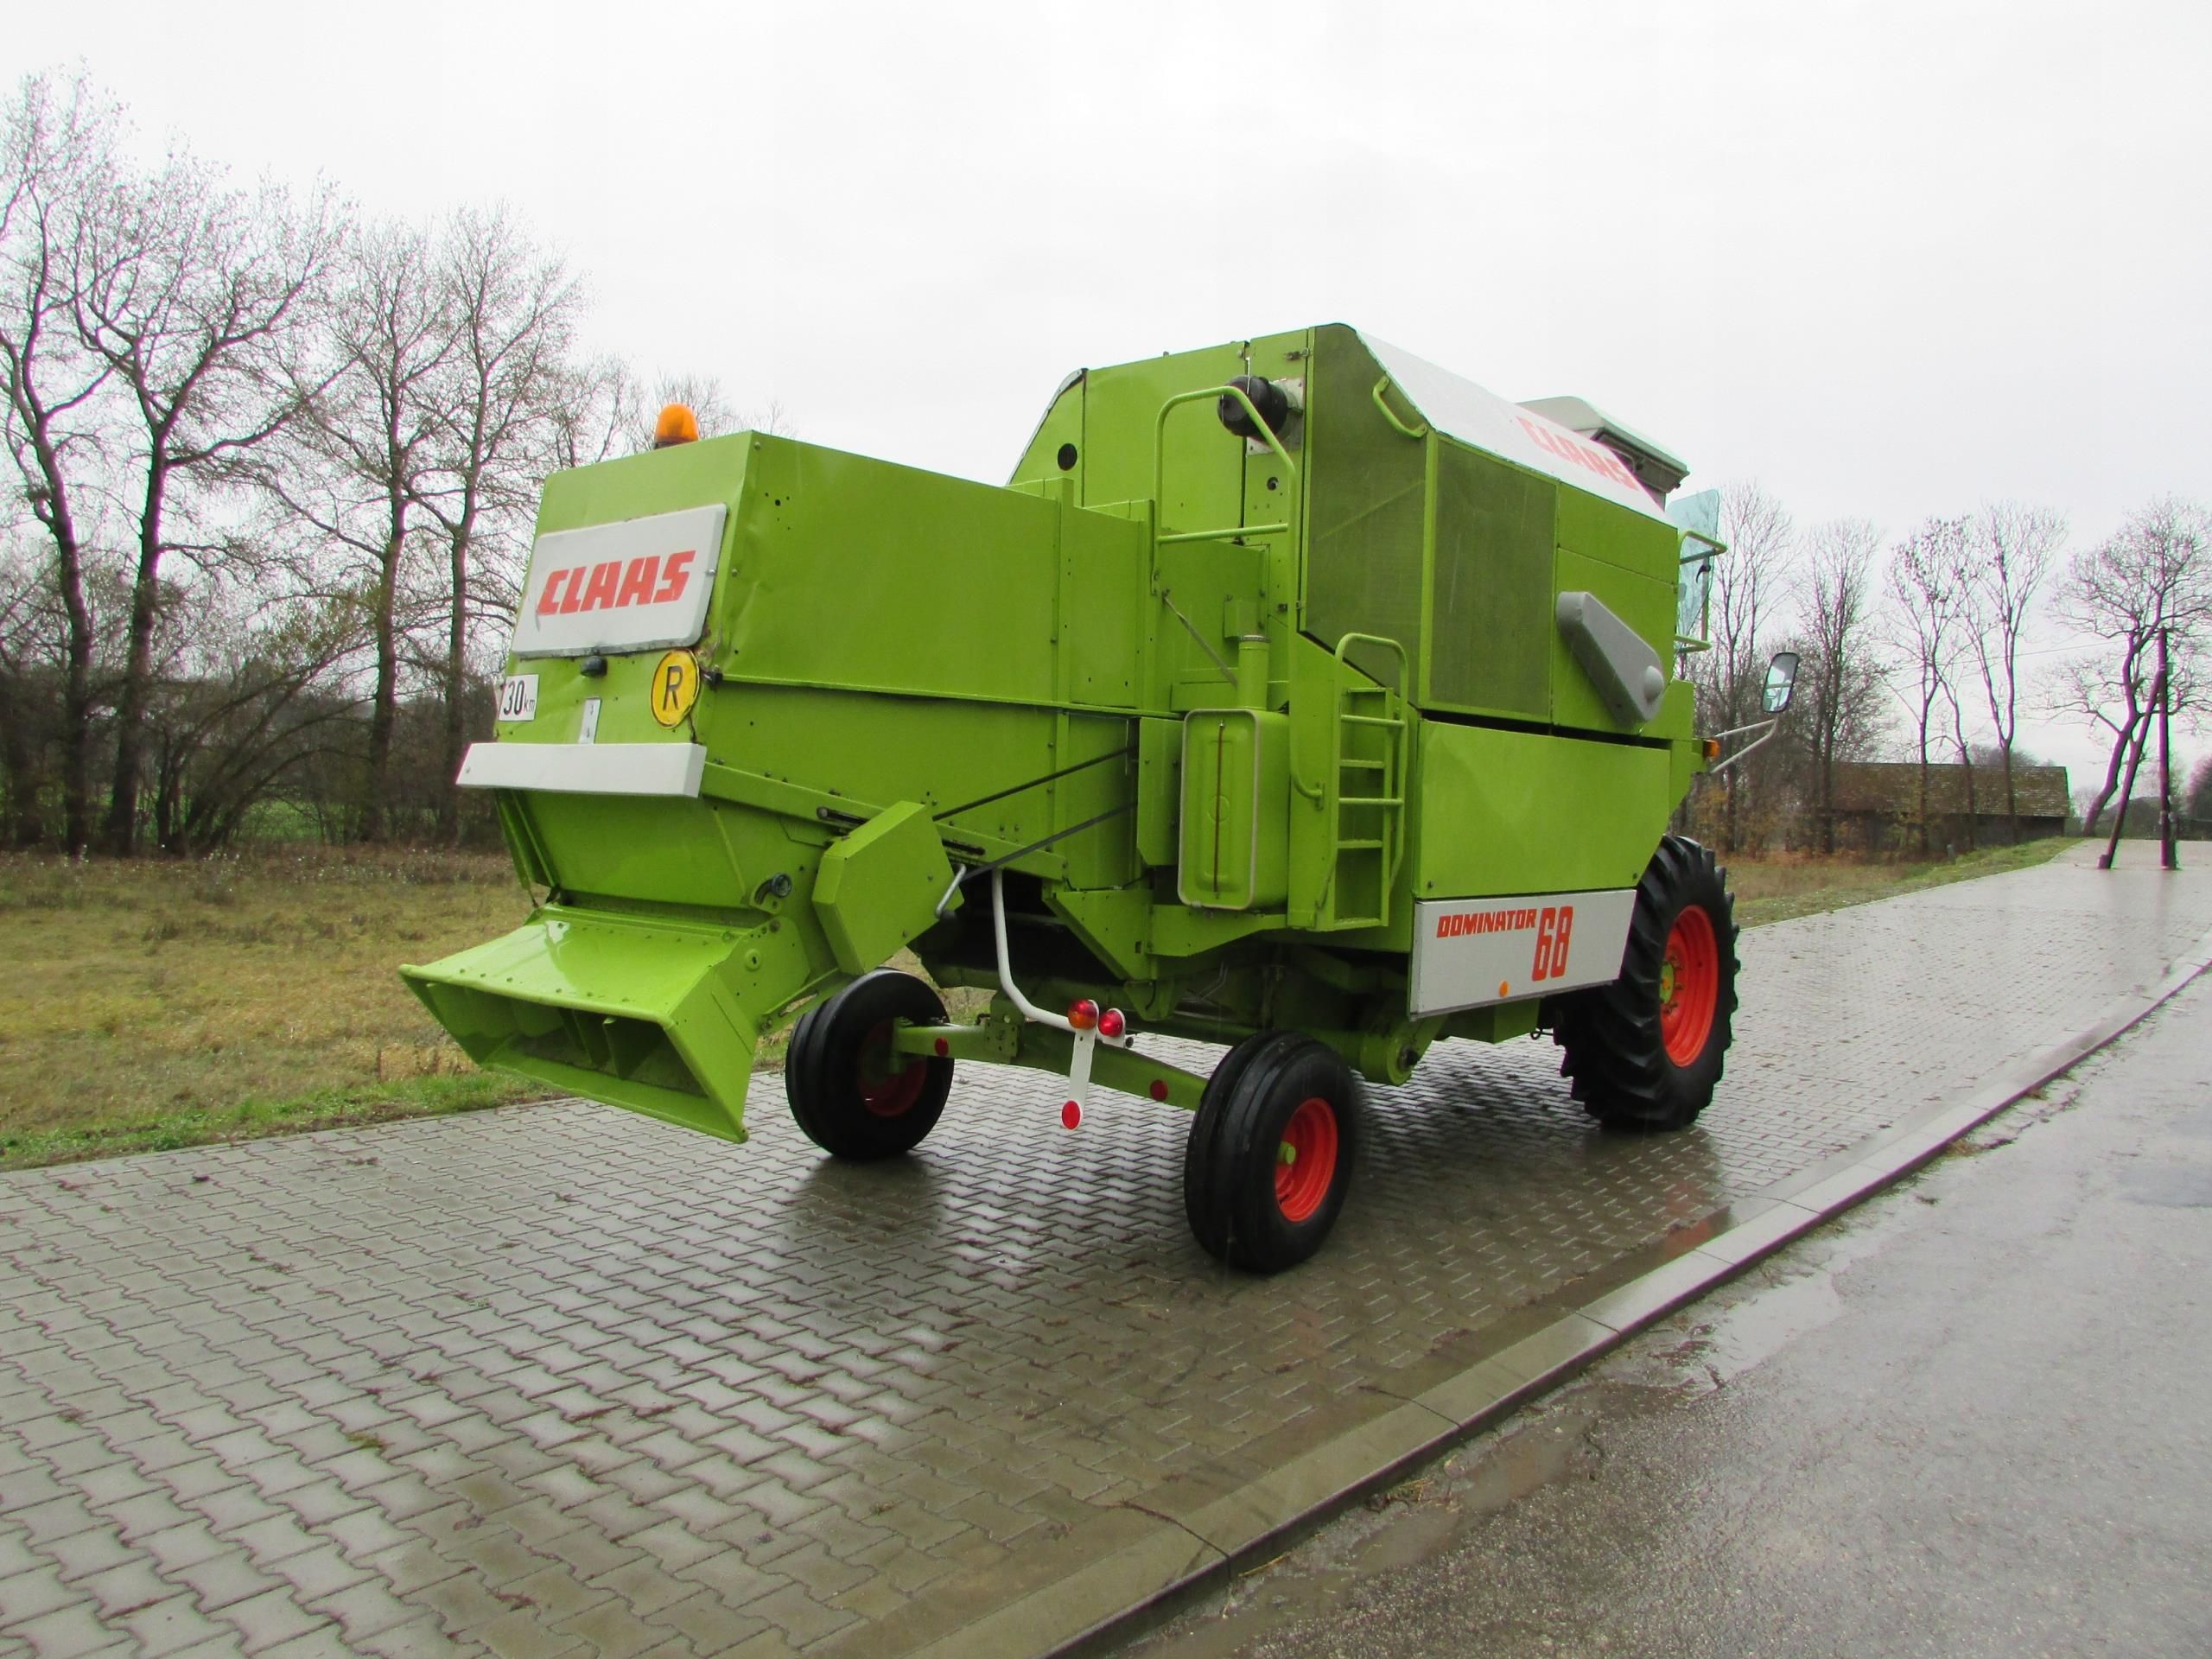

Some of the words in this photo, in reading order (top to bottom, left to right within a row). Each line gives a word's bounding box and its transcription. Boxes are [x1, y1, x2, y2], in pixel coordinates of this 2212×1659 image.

[1516, 416, 1639, 492] CLAAS
[536, 550, 696, 616] CLAAS
[503, 679, 525, 715] 30
[524, 694, 536, 713] km
[662, 664, 683, 711] R
[1436, 908, 1537, 938] DOMINATOR
[1531, 905, 1573, 982] 68
